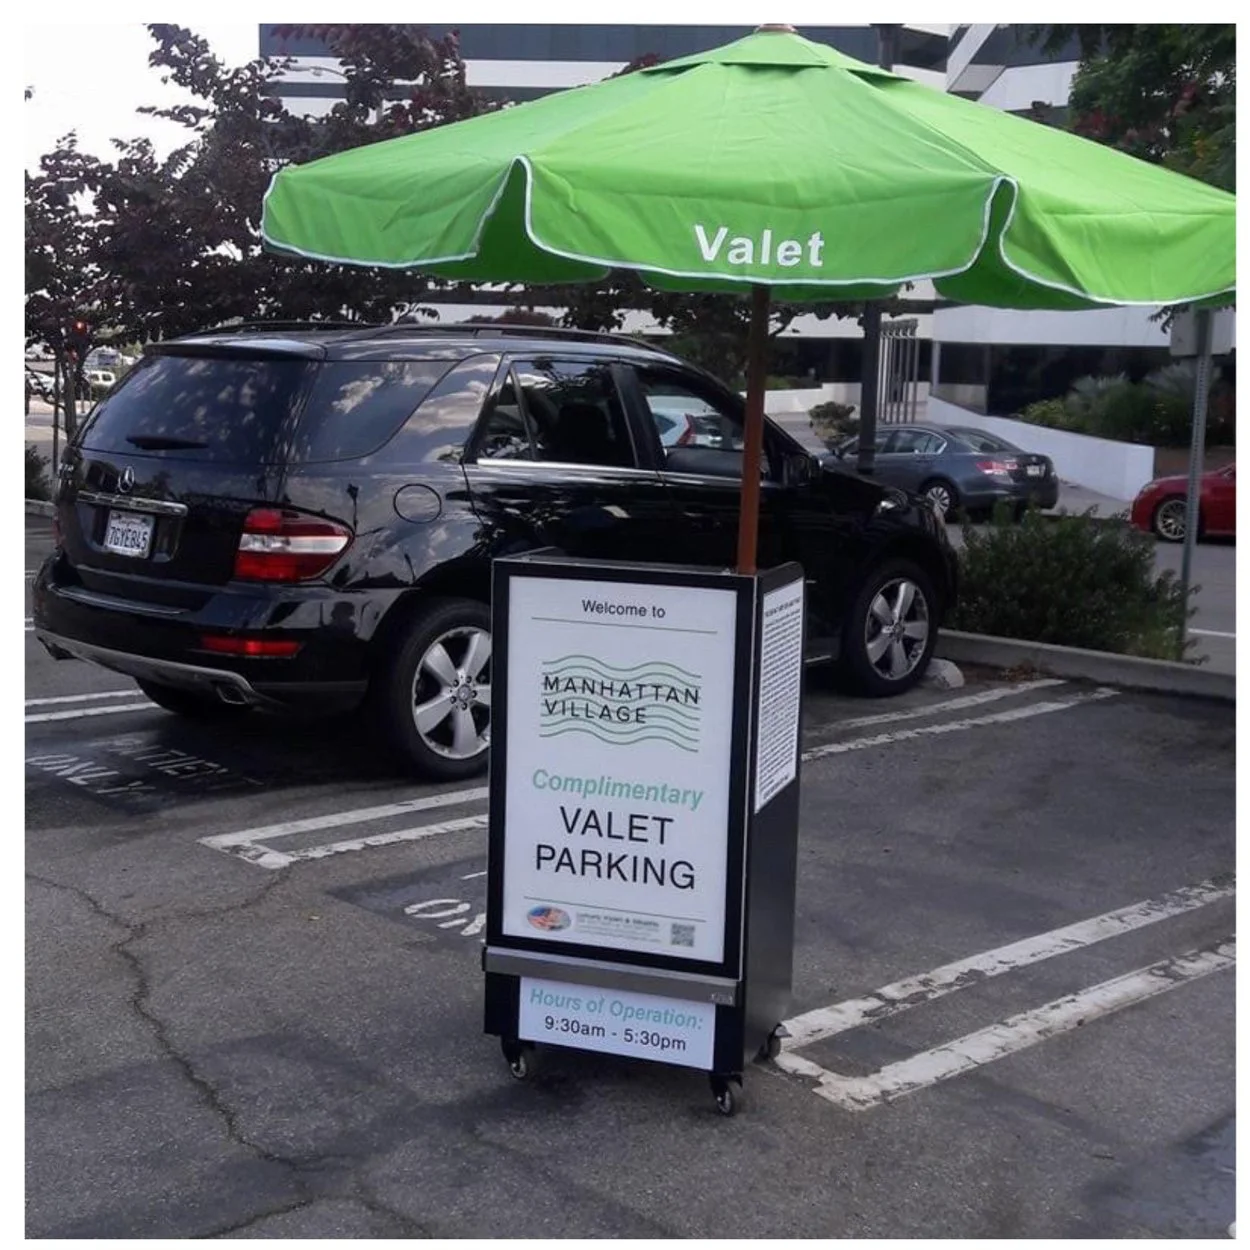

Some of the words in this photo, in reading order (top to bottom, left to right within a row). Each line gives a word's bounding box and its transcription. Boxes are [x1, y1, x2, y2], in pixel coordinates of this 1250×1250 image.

[694, 224, 825, 267] Valet
[582, 600, 647, 617] Welcome
[652, 606, 666, 619] to
[543, 676, 699, 704] MANHATTAN
[544, 700, 647, 723] VILLAGE
[532, 769, 704, 810] Complimentary
[560, 806, 674, 845] VALET
[536, 844, 696, 889] PARKING
[530, 987, 581, 1011] Hours
[586, 995, 604, 1013] of
[610, 1000, 703, 1029] Operation:
[545, 1016, 606, 1037] 9:30am
[624, 1028, 686, 1051] 5:30pm
